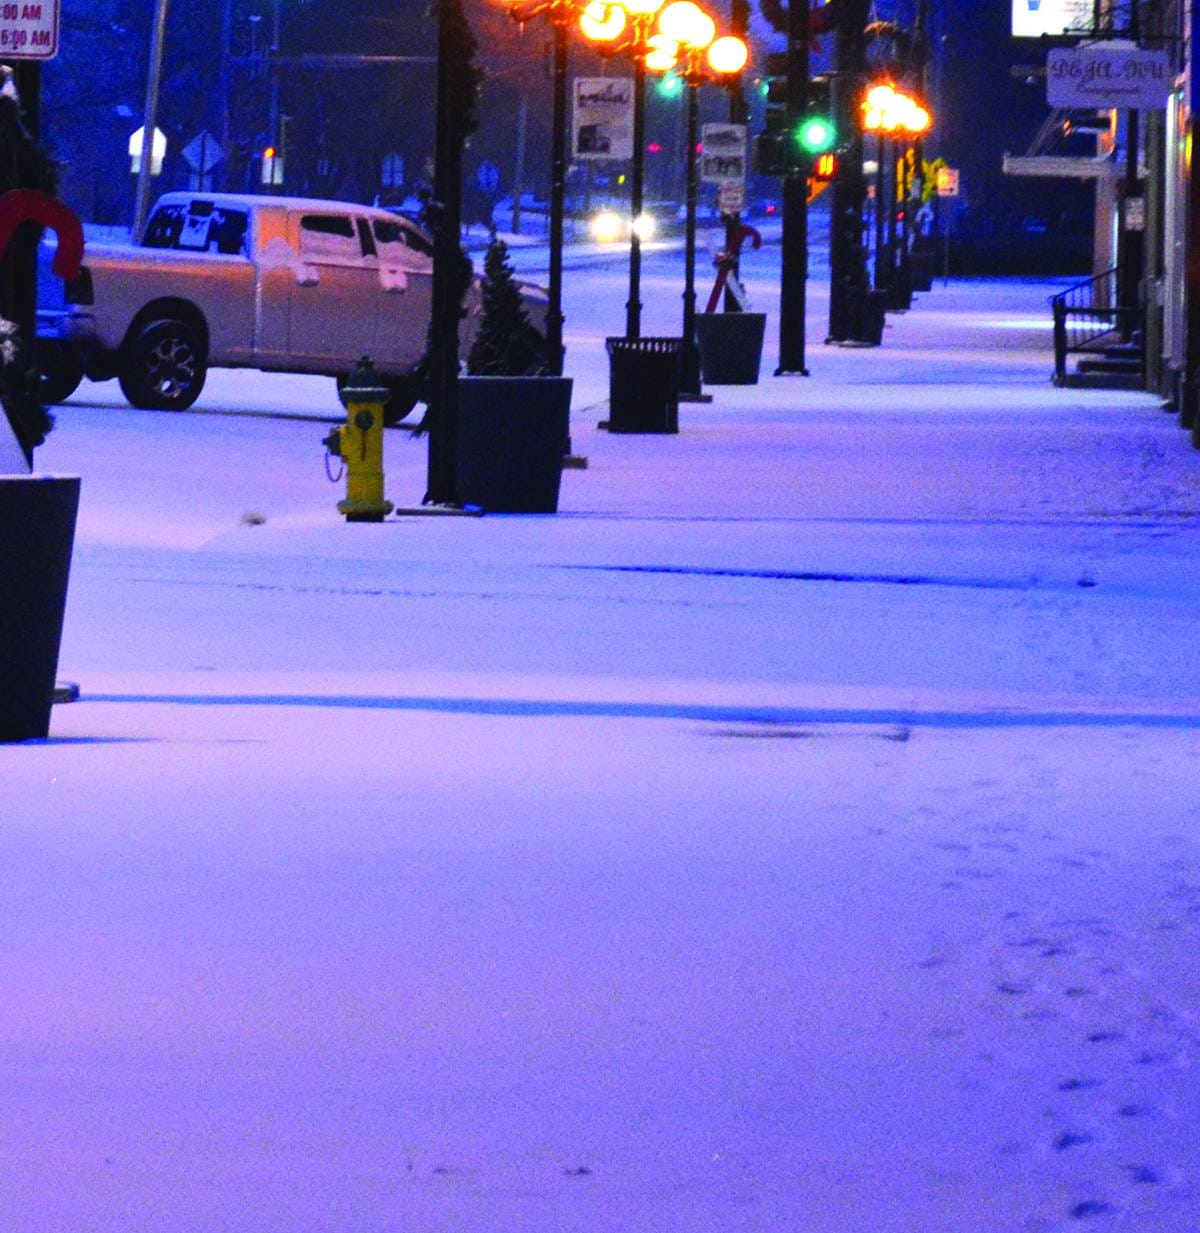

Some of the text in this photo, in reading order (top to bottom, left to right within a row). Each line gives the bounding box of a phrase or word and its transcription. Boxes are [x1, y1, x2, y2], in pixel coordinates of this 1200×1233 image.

[22, 4, 42, 20] AM
[1, 29, 27, 46] 6:00
[30, 30, 50, 46] AM
